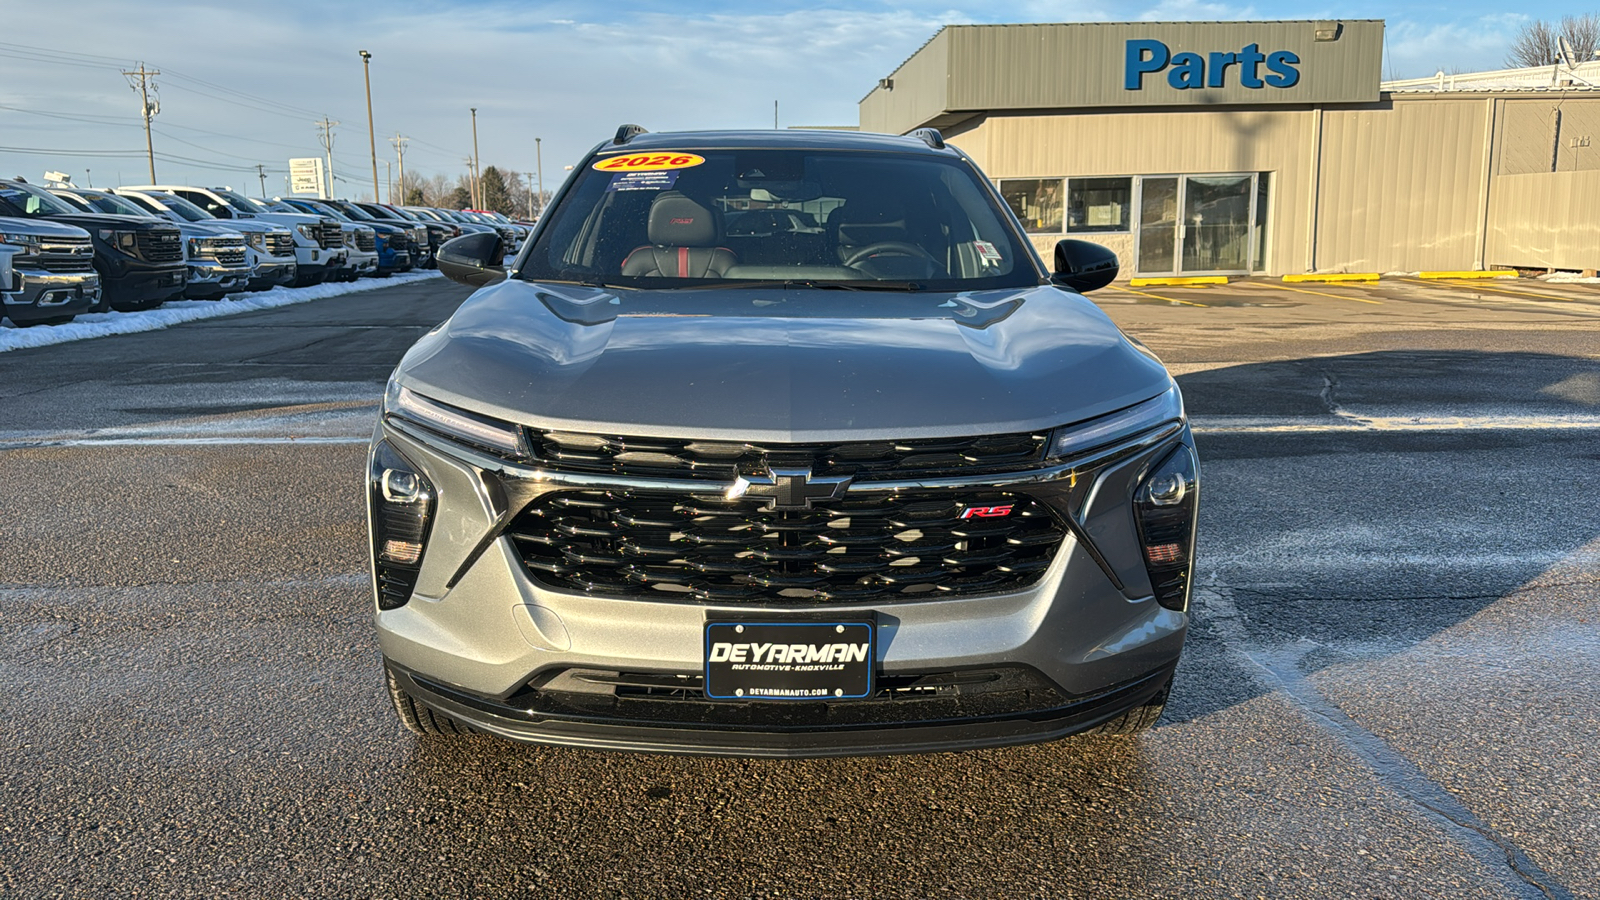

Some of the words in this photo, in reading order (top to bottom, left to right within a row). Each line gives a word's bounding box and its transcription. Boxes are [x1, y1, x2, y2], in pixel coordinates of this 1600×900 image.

[1124, 39, 1300, 90] Parts
[604, 156, 693, 169] 2026
[960, 505, 1014, 518] RS
[709, 642, 869, 664] DEYARMAN
[749, 688, 828, 696] DEYARMANAUTO.COM
